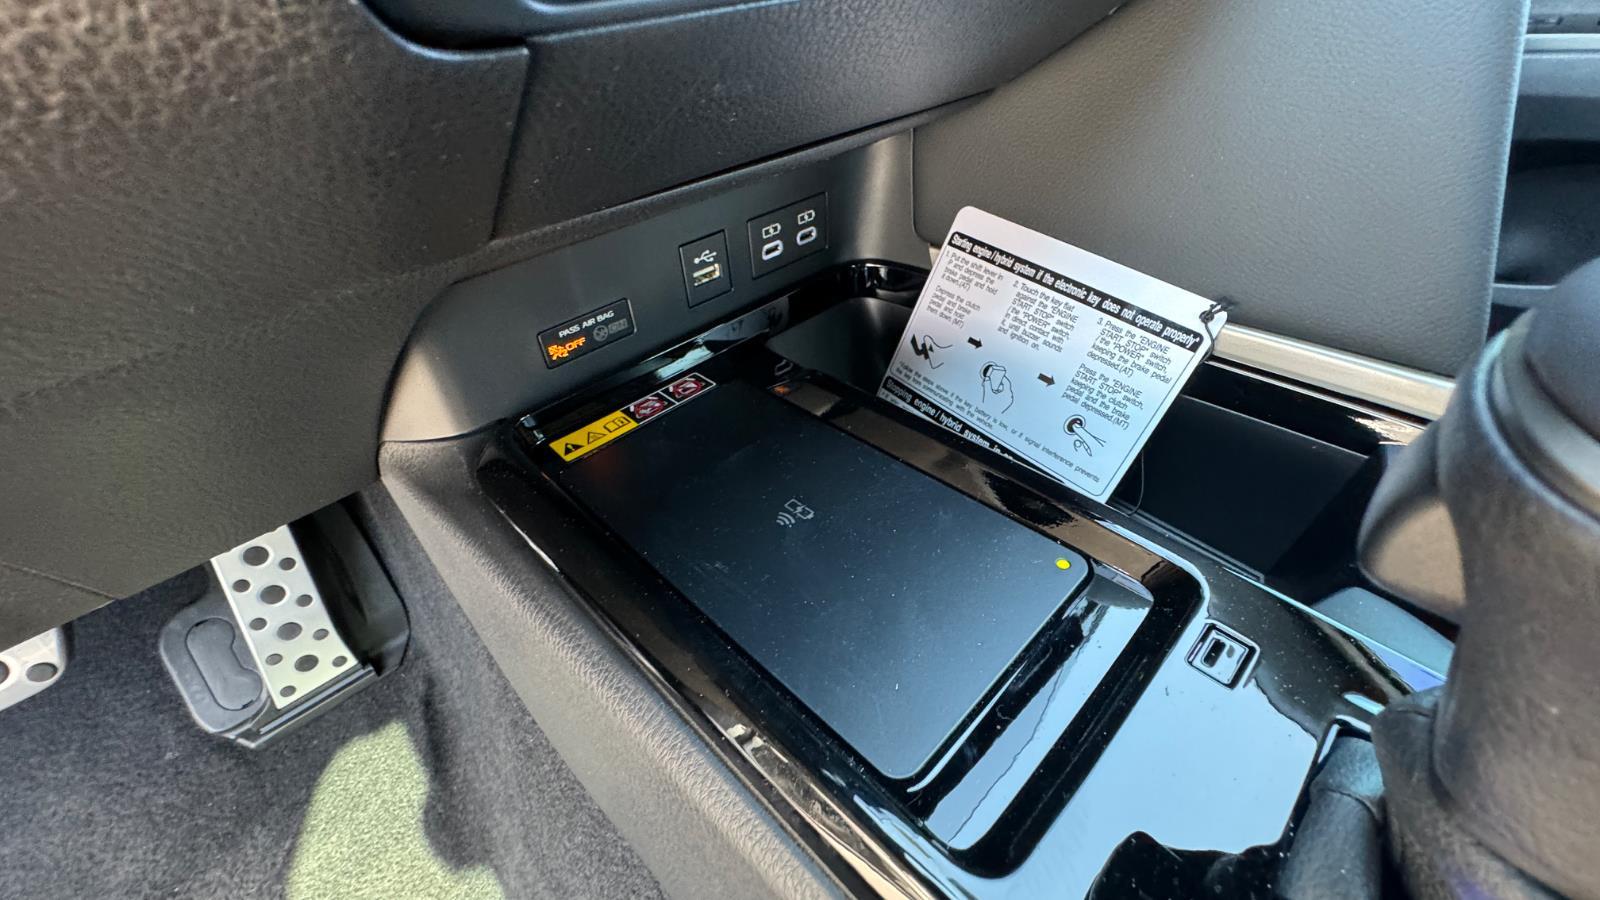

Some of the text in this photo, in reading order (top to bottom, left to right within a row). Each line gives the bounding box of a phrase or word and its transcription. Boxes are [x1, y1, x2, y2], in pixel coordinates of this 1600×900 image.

[950, 251, 961, 261] Put
[959, 256, 970, 266] the
[969, 260, 983, 271] shift
[982, 266, 997, 277] lever
[996, 272, 1004, 281] in
[952, 261, 964, 271] and
[984, 275, 995, 285] the
[950, 233, 974, 252] Starting
[1011, 260, 1037, 279] system
[1035, 269, 1044, 280] if
[1041, 272, 1056, 286] the
[1053, 277, 1089, 299] electronic
[1084, 290, 1102, 308] key
[1100, 297, 1122, 314] does
[1120, 306, 1136, 320] not
[1132, 312, 1165, 334] operate
[973, 280, 985, 289] and
[985, 285, 998, 295] hold
[1019, 283, 1039, 296] Touch
[1038, 291, 1051, 301] the
[1049, 296, 1063, 308] key
[1062, 301, 1075, 312] flat
[943, 305, 953, 314] and
[946, 299, 957, 308] and
[955, 295, 964, 303] the
[1014, 290, 1037, 305] against
[1037, 300, 1048, 309] the
[559, 324, 580, 338] PASS
[582, 318, 596, 329] AIR
[597, 310, 614, 322] BAG
[1004, 311, 1065, 344] in direct contact with
[1011, 297, 1033, 311] START
[1055, 318, 1075, 331] switch
[1096, 316, 1105, 325] 3.
[1103, 320, 1124, 334] Press
[1124, 329, 1137, 339] the
[565, 336, 586, 350] OFF
[997, 325, 1008, 334] and
[1008, 331, 1029, 346] ignition
[1007, 321, 1020, 332] until
[1021, 328, 1041, 341] buzzer
[1041, 338, 1063, 353] sounds
[1099, 327, 1124, 343] START
[1149, 350, 1172, 365] switch
[1078, 362, 1098, 376] Press
[1098, 372, 1110, 383] the
[1089, 342, 1172, 385] keeping the brake pedal
[1144, 357, 1169, 374] switch,
[1061, 390, 1080, 405] pedal
[1065, 383, 1131, 421] pedal and the brake
[1069, 377, 1129, 410] keeping the clutch
[1074, 369, 1097, 385] START
[1121, 393, 1146, 410] switch,
[884, 378, 914, 403] Stopping
[962, 427, 991, 449] system
[966, 410, 974, 418] the
[954, 395, 963, 403] the
[963, 400, 972, 409] key
[973, 406, 992, 420] battery
[1023, 435, 1041, 449] signal
[1041, 445, 1074, 468] interference
[1073, 464, 1100, 484] prevents
